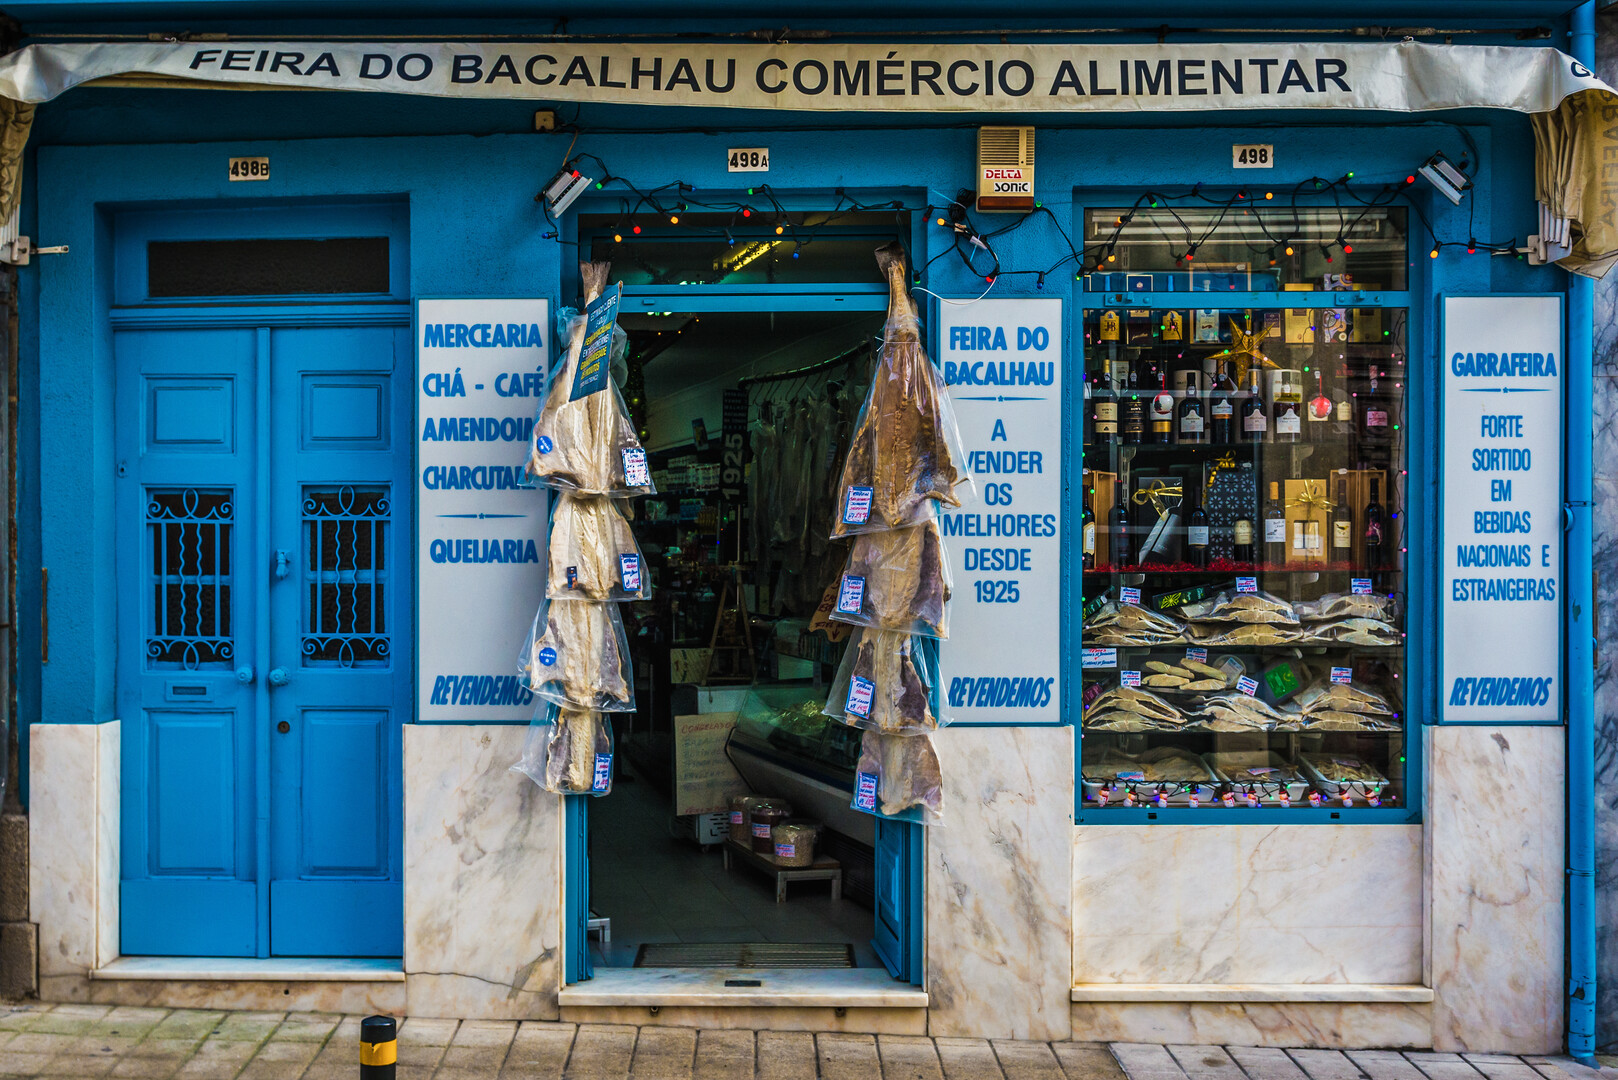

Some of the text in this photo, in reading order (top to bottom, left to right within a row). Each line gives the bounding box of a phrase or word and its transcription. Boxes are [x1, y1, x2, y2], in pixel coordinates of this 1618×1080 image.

[190, 49, 1352, 97] FEIRA DO BACALHAU COMÉRCIO ALIMENTAR
[231, 160, 269, 176] 498B
[730, 152, 768, 167] 498A
[1238, 148, 1268, 164] 498
[985, 169, 1022, 179] DELTA
[424, 324, 543, 347] MERCEARIA
[949, 326, 1050, 351] FEIRA DO
[944, 361, 1055, 386] BACALHAU
[1451, 352, 1558, 377] GARRAFEIRA
[423, 367, 467, 397] CHÁ
[494, 365, 545, 397] CAFÉ
[991, 418, 1008, 442] A
[1480, 415, 1524, 438] FORTE
[722, 433, 744, 500] 1925
[1471, 448, 1532, 472] SORTIDO
[423, 465, 546, 490] CHARCUTA
[984, 483, 1013, 506] OS
[1491, 479, 1512, 502] EM
[943, 514, 1057, 537] MELHORES
[1474, 511, 1532, 534] BEBIDAS
[429, 539, 539, 563] QUEIJARIA
[964, 548, 1032, 572] DESDE
[1456, 544, 1551, 568] NACIONAIS E
[974, 580, 1021, 604] 1925
[1452, 578, 1556, 602] ESTRANGEIRAS
[429, 675, 536, 706] REVENDEMOS
[948, 677, 1055, 708] REVENDEMOS
[1448, 677, 1553, 707] REVENDEMOS
